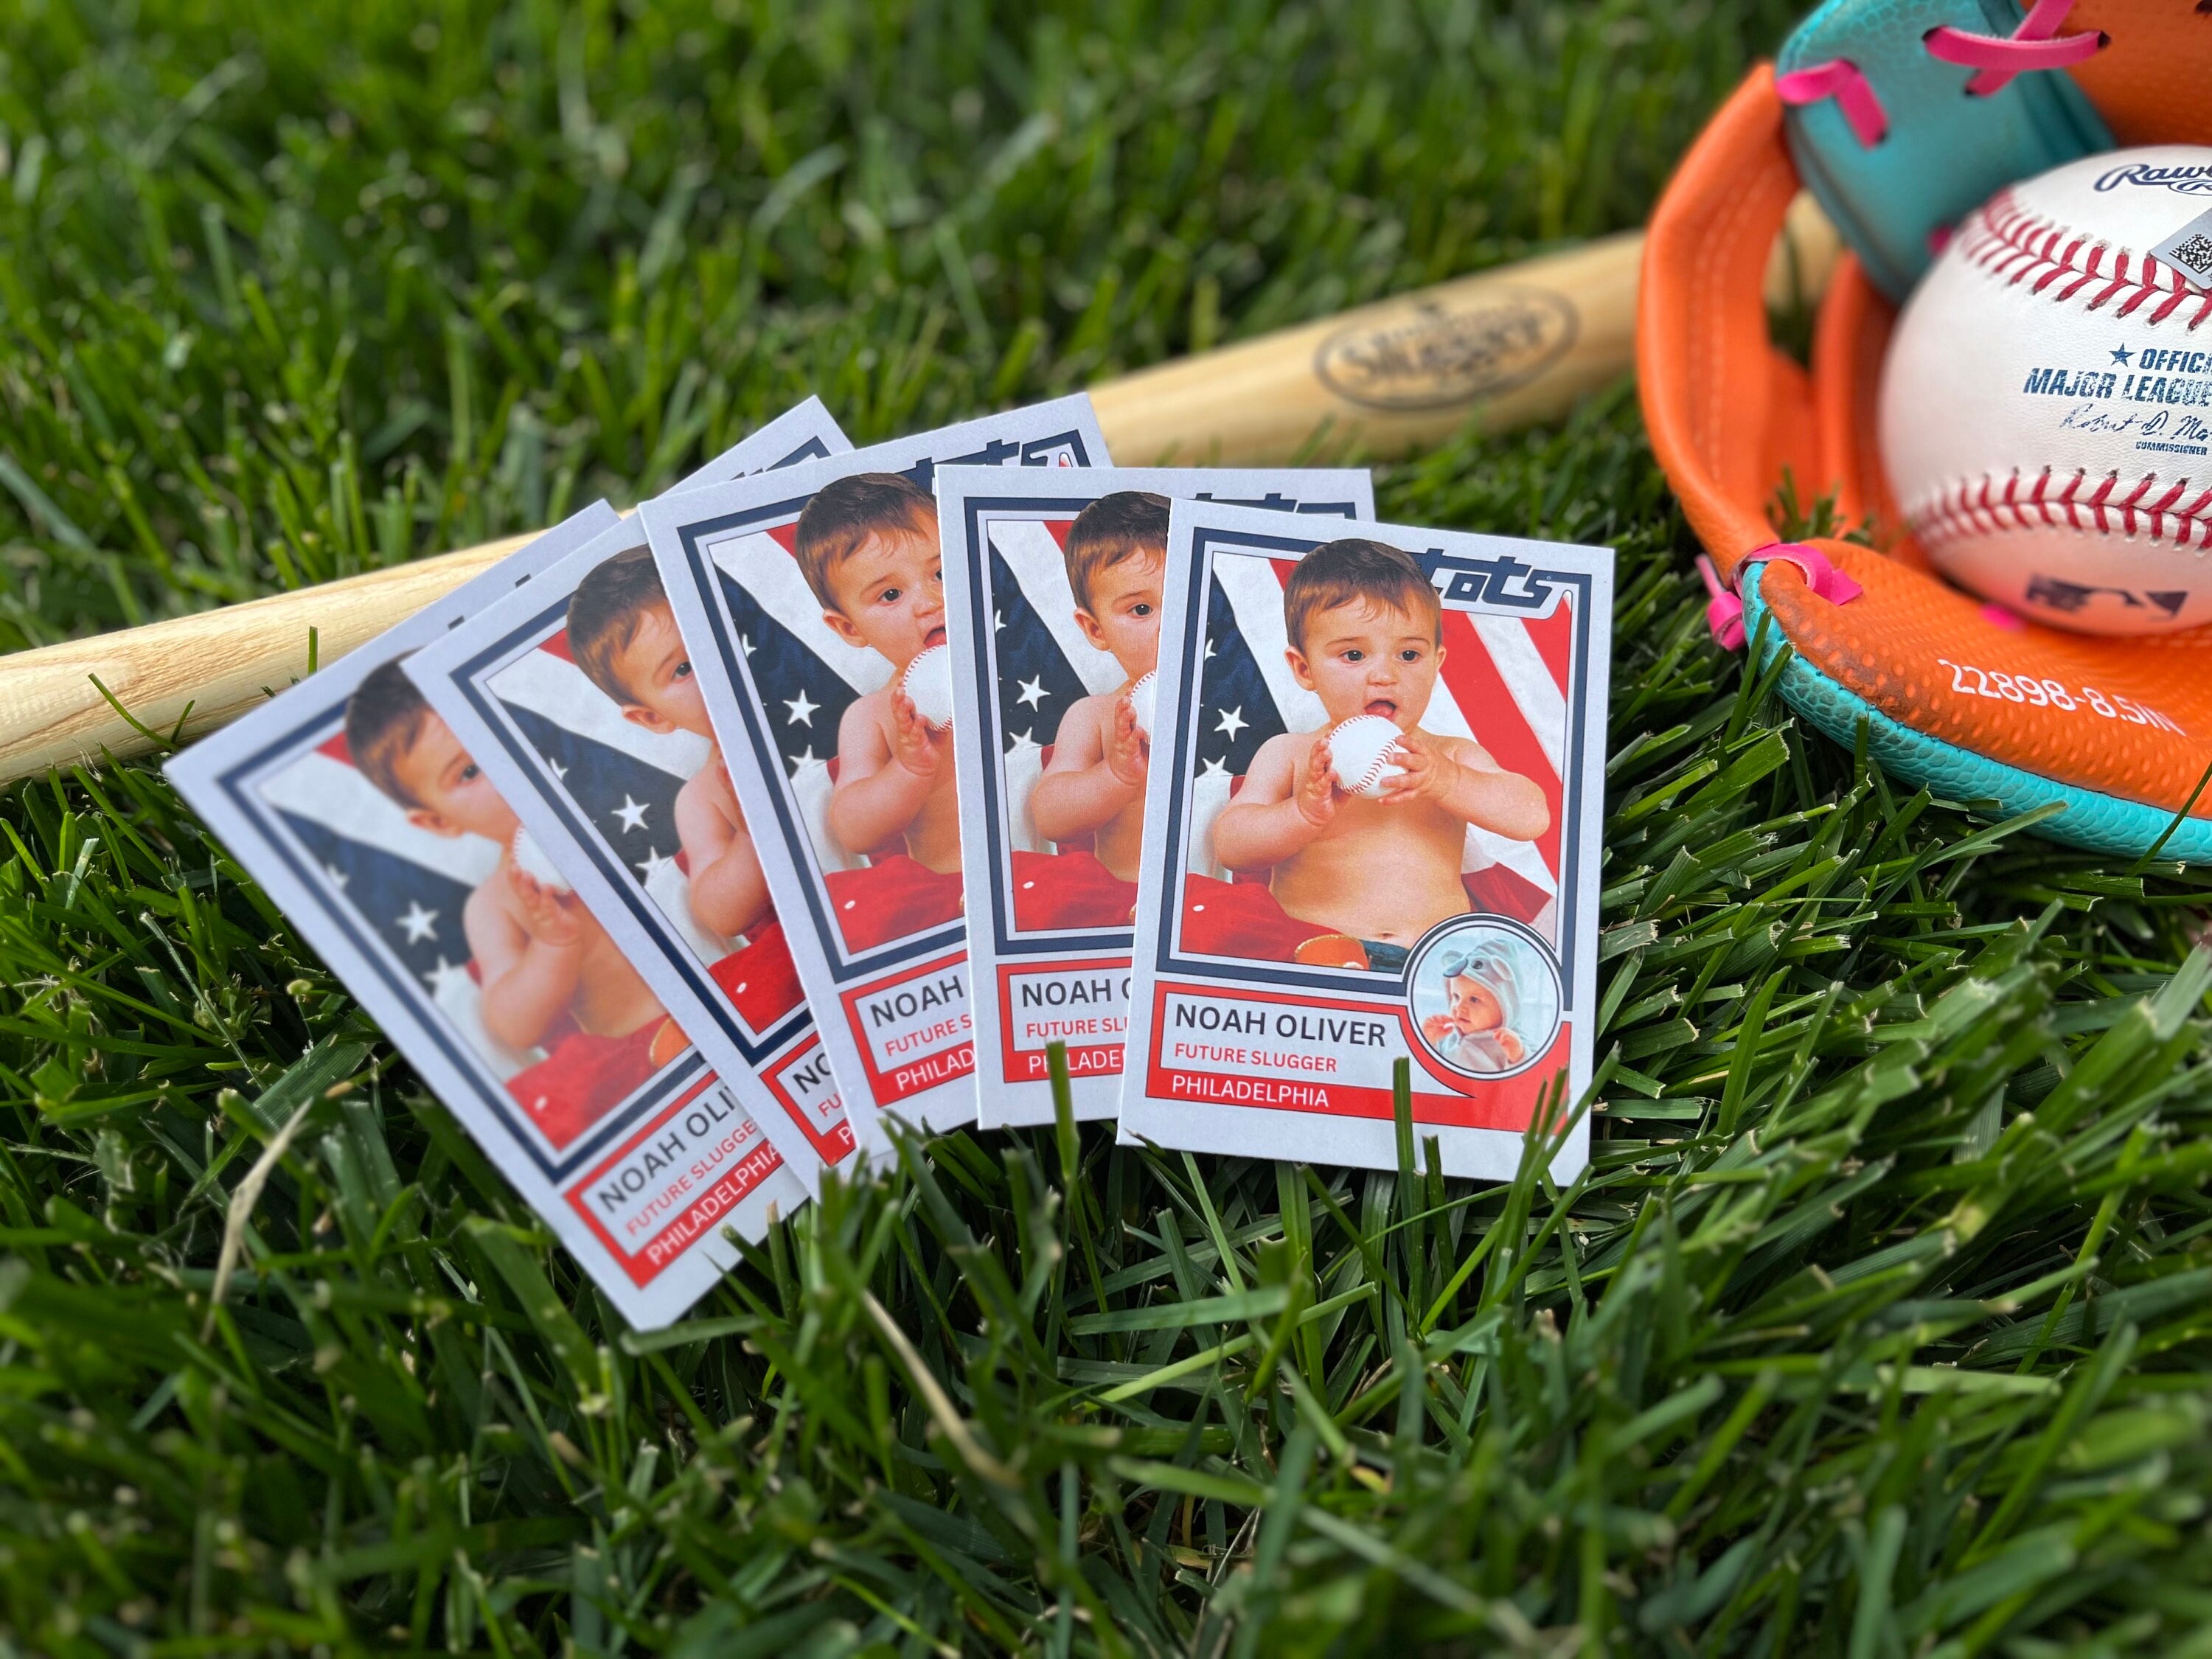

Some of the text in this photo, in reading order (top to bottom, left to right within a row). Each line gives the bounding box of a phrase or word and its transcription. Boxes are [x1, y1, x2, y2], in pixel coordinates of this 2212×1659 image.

[2139, 348, 2212, 375] OFFICI
[2023, 368, 2117, 399] MAJOR
[2135, 441, 2208, 456] COMMISSIONER
[869, 975, 964, 1028] NOAH
[1022, 978, 1112, 1007] NOAH
[886, 1018, 959, 1057] FUTURE
[1026, 1019, 1098, 1037] FUTURE
[1175, 1004, 1386, 1047] NOAH OLIVER
[1175, 1043, 1337, 1072] FUTURE SLUGGER
[1172, 1075, 1329, 1107] PHILADELPHIA
[598, 1132, 687, 1213] NOAH
[625, 1175, 694, 1237] FUTURE
[646, 1143, 782, 1266] PHILADELPHIA
